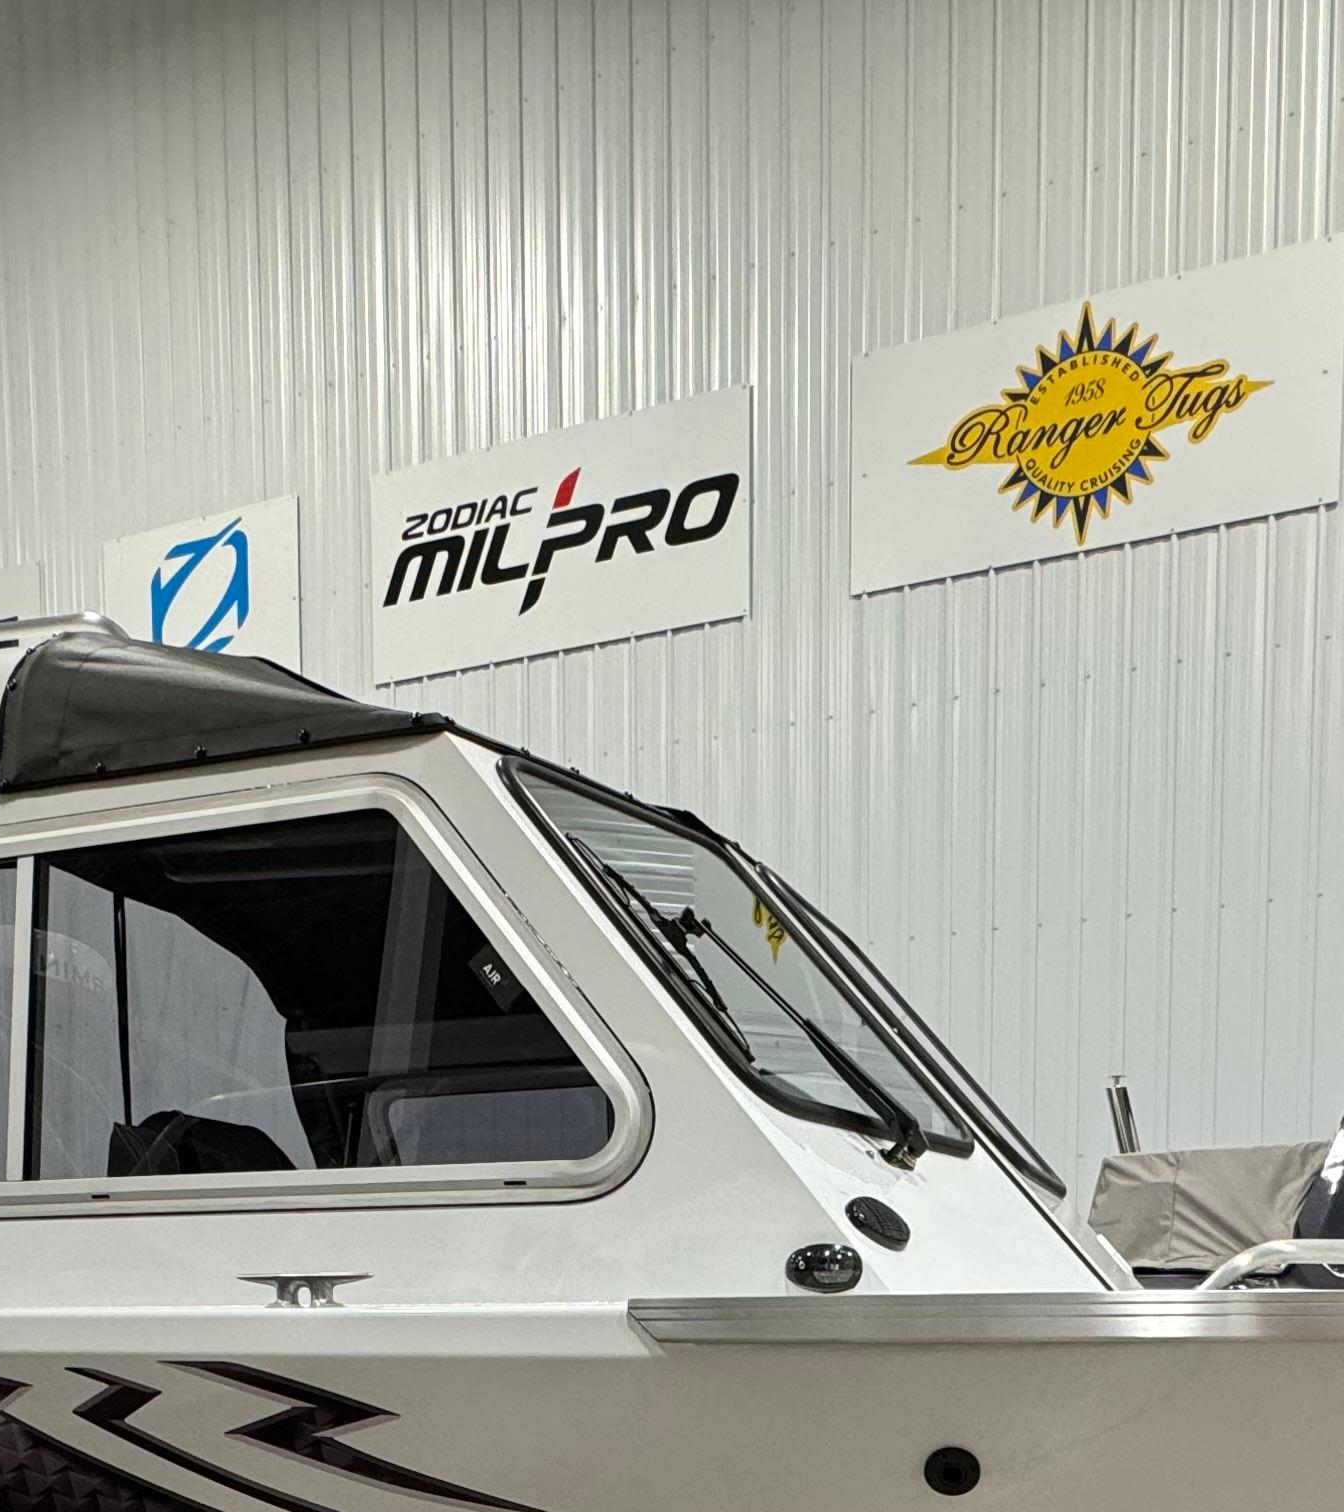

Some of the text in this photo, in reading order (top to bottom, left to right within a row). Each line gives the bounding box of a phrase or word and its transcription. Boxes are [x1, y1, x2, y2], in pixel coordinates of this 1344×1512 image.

[1030, 355, 1140, 405] ESTABLISHED
[1065, 377, 1107, 407] 1958
[946, 359, 1248, 470] Ranger Tugs
[1025, 438, 1141, 493] QUALITY CRUISING
[401, 487, 539, 541] ZODIAC
